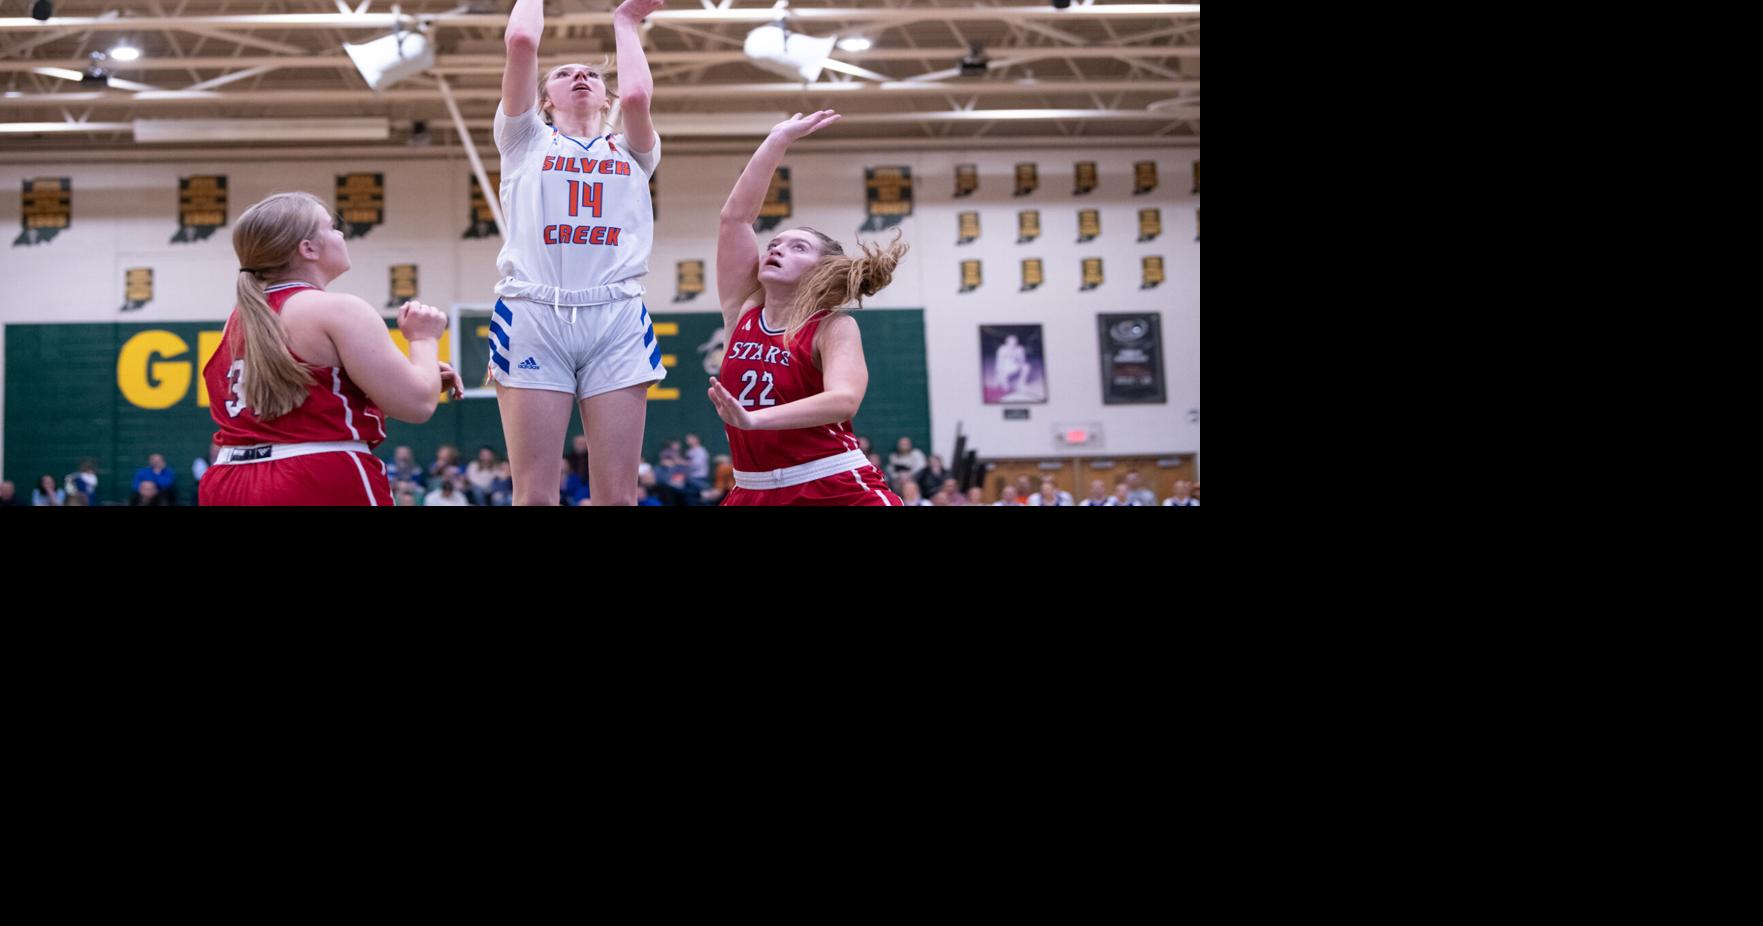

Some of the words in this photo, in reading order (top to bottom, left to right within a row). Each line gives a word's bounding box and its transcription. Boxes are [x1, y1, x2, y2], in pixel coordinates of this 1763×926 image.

[542, 155, 631, 177] SILVER
[566, 179, 604, 218] 14
[543, 223, 622, 247] CREEK
[728, 341, 792, 367] STARS
[737, 369, 776, 407] 22
